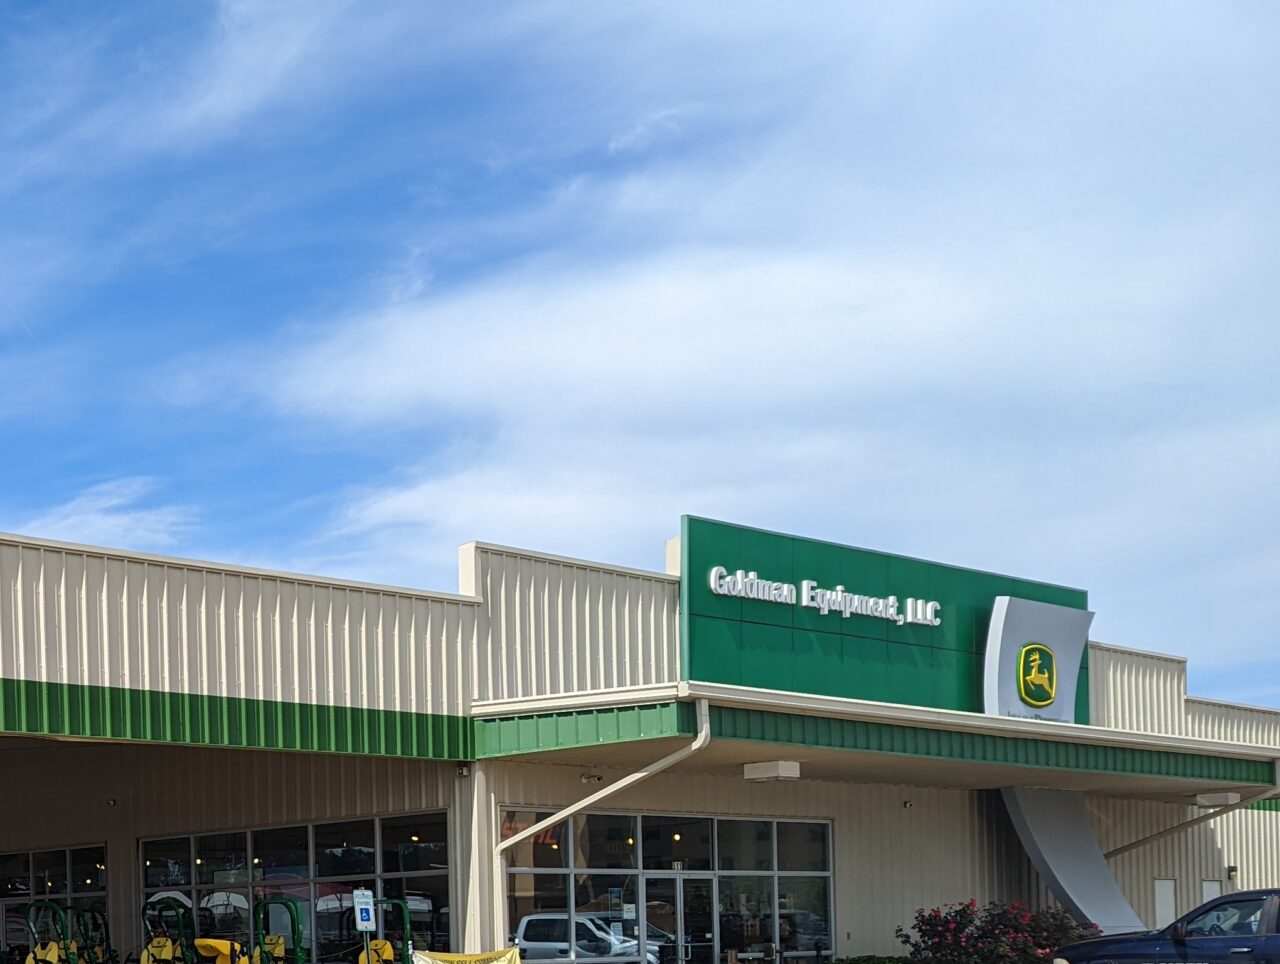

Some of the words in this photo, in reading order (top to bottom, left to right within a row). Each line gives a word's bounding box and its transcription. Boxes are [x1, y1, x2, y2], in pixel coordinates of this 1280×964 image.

[709, 565, 796, 605] Goldman
[801, 579, 904, 625] Equipment,
[905, 597, 942, 626] LLC
[500, 820, 558, 844] STL
